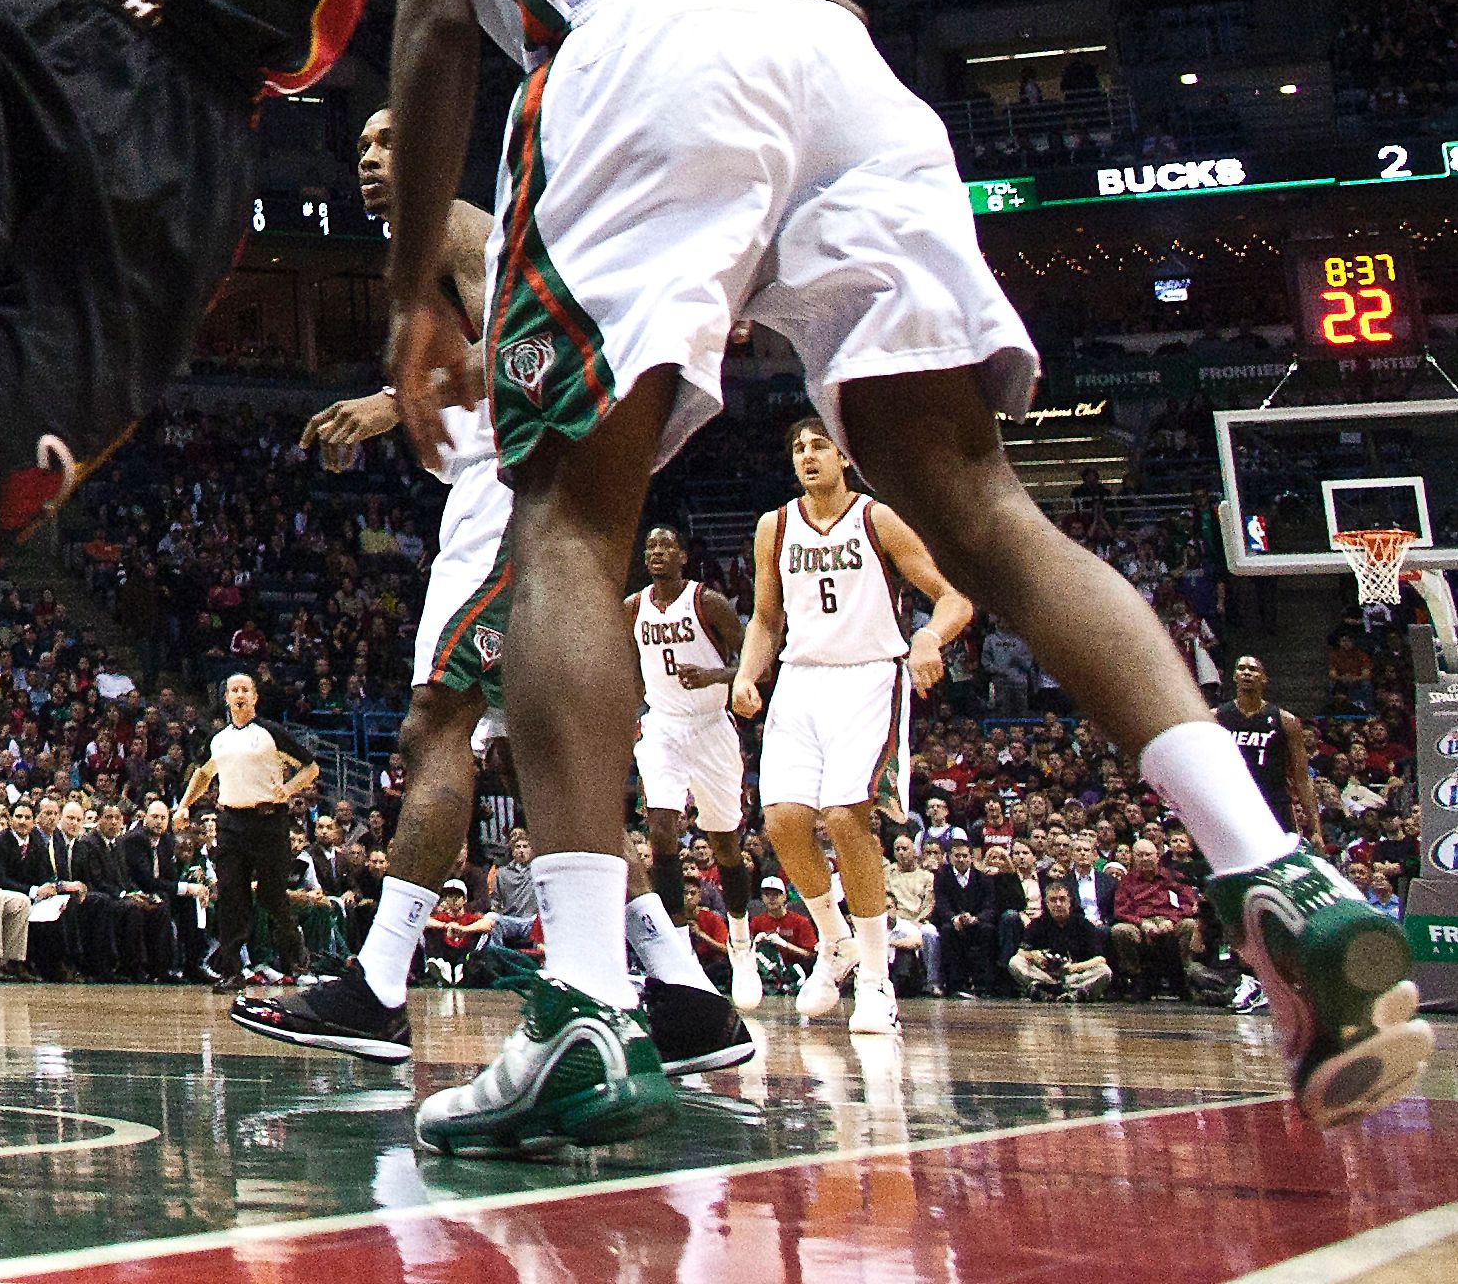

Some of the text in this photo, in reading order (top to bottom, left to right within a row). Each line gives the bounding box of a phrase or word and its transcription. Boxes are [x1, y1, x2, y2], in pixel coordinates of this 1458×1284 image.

[1097, 157, 1247, 196] BUCKS
[1377, 144, 1413, 179] 2
[1324, 253, 1396, 287] 8:37
[1322, 288, 1394, 344] 22
[788, 538, 863, 574] BUCKS
[818, 577, 838, 614] 6
[641, 616, 695, 646] BUCKS
[662, 648, 677, 677] 8
[1257, 749, 1265, 765] 1
